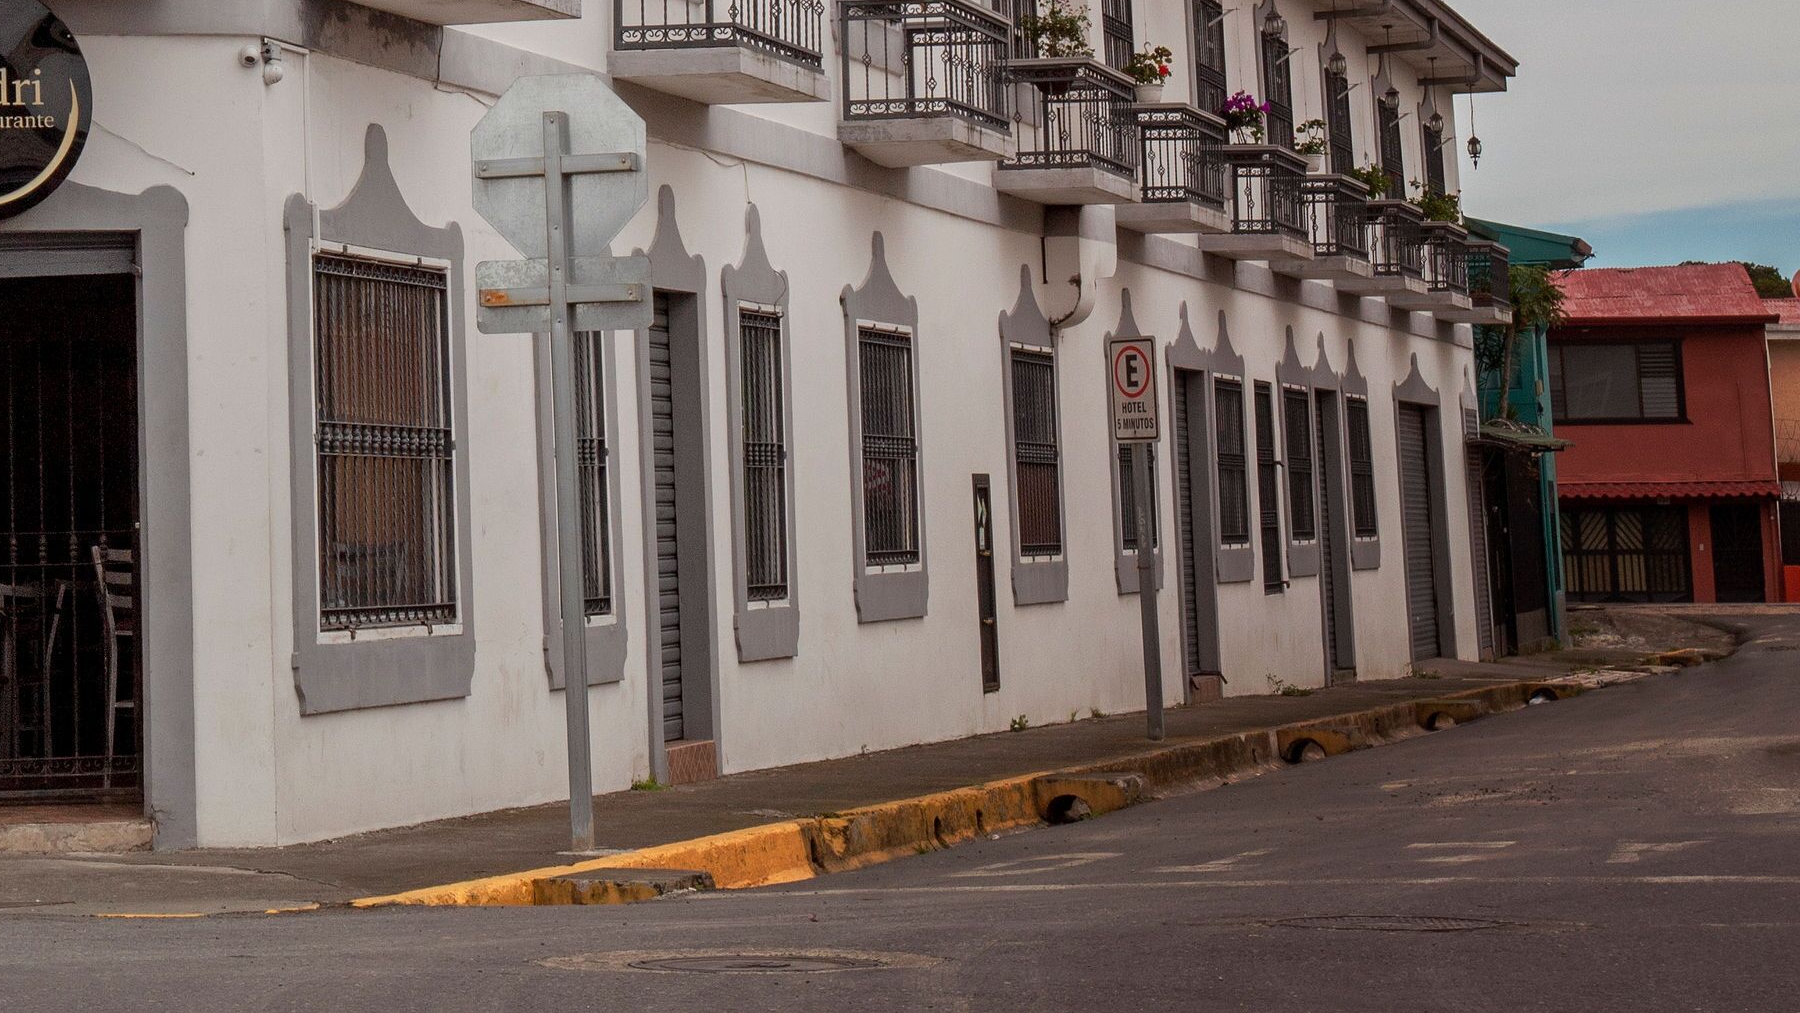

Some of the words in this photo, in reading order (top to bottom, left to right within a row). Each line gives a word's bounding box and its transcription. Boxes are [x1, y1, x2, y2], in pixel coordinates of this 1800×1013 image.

[1125, 354, 1139, 387] E
[1122, 401, 1147, 413] HOTEL
[1117, 419, 1121, 430] 5
[1122, 417, 1154, 430] MINUTOS
